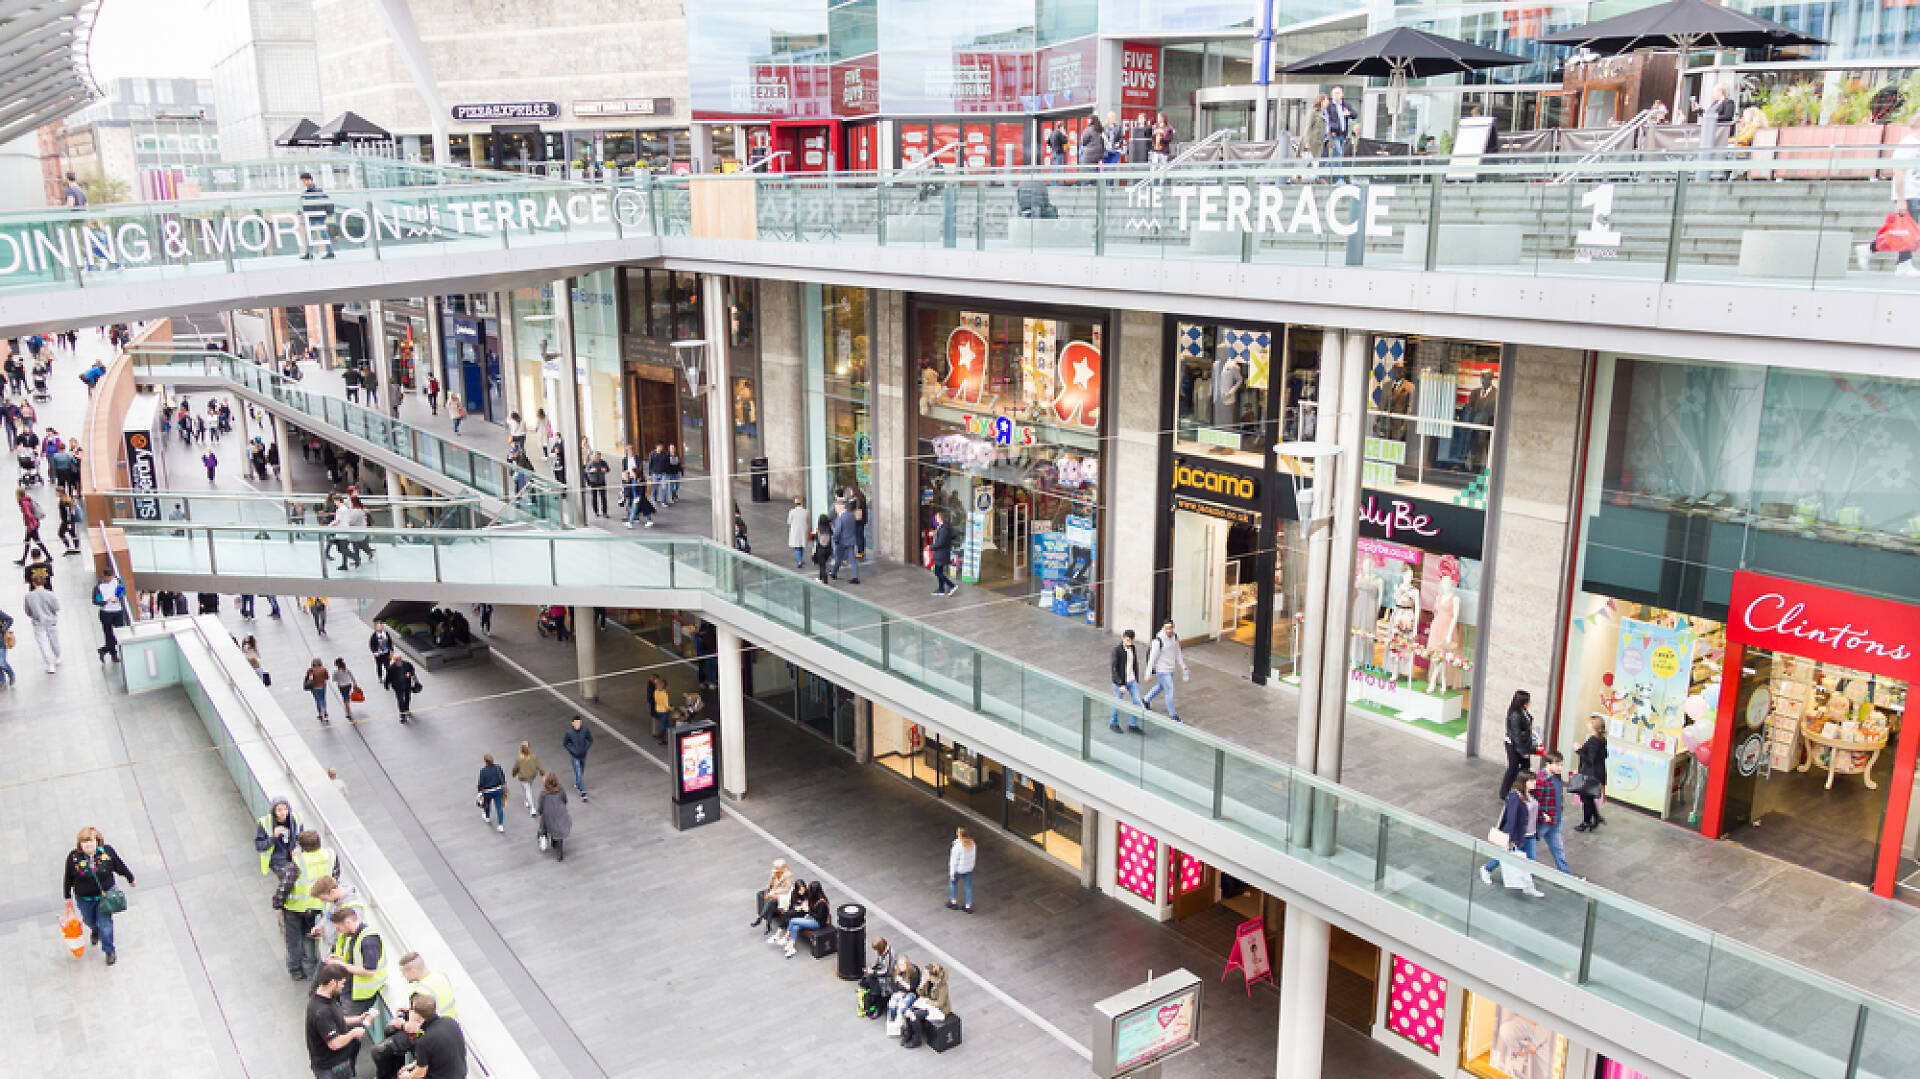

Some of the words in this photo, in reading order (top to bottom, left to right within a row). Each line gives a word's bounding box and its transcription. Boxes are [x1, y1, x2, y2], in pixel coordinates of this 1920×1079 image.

[1121, 70, 1157, 89] GUYS
[1124, 50, 1153, 70] FIVE
[954, 83, 992, 96] HIRING
[0, 222, 150, 275] DINING
[164, 219, 193, 258] &
[200, 209, 332, 255] MORE
[339, 207, 402, 243] ON
[402, 204, 440, 222] THE
[448, 191, 610, 234] TERRACE
[1124, 186, 1163, 208] THE
[1171, 185, 1397, 237] TERRACE
[1576, 184, 1622, 247] 1
[135, 448, 157, 519] suerdry
[1172, 459, 1255, 499] jacamo
[1744, 592, 1911, 660] Clintons
